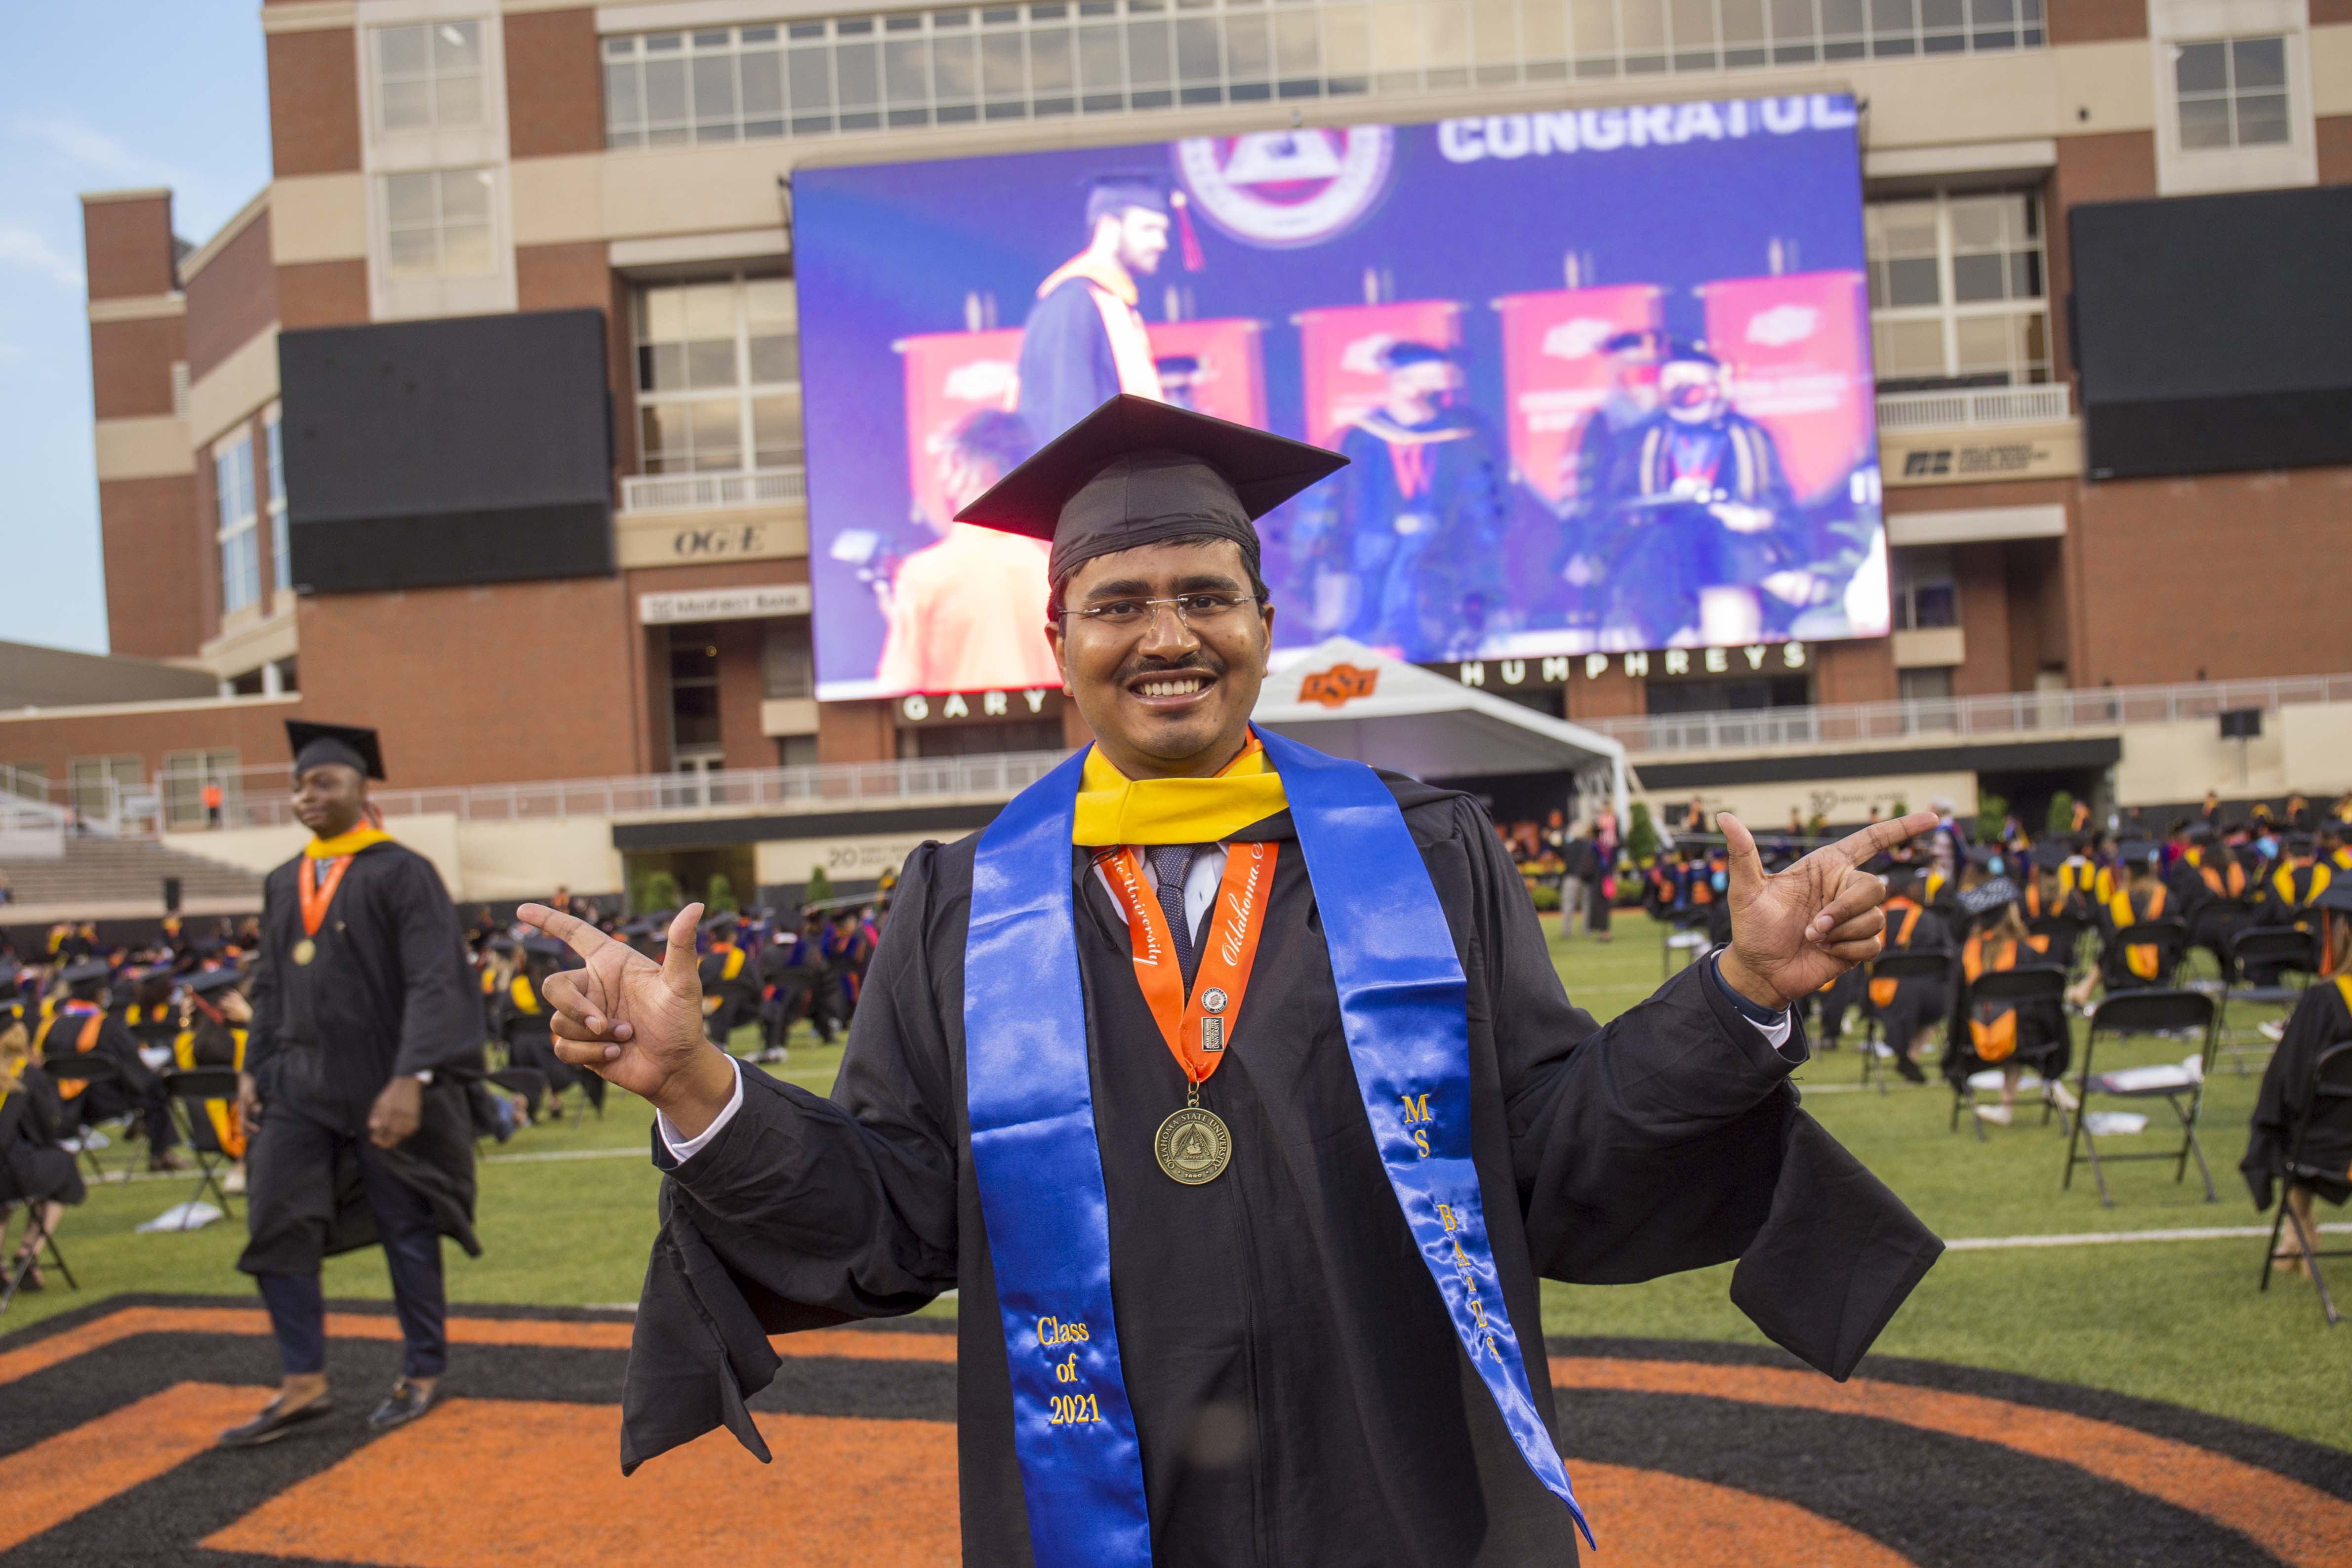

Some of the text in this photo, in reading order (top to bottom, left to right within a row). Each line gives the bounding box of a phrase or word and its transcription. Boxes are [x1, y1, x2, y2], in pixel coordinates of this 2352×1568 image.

[1460, 642, 1807, 686] HUMPHREYS
[903, 689, 1046, 720] GARY
[1124, 873, 1162, 967] University
[1222, 865, 1260, 966] Oklahoma
[1161, 1120, 1179, 1169] OKLAHOMA
[1181, 1113, 1208, 1122] STATE
[1210, 1119, 1227, 1170] UNIVERSITY
[1037, 1316, 1089, 1345] Class
[1056, 1353, 1078, 1383] of
[1051, 1394, 1101, 1424] 2021
